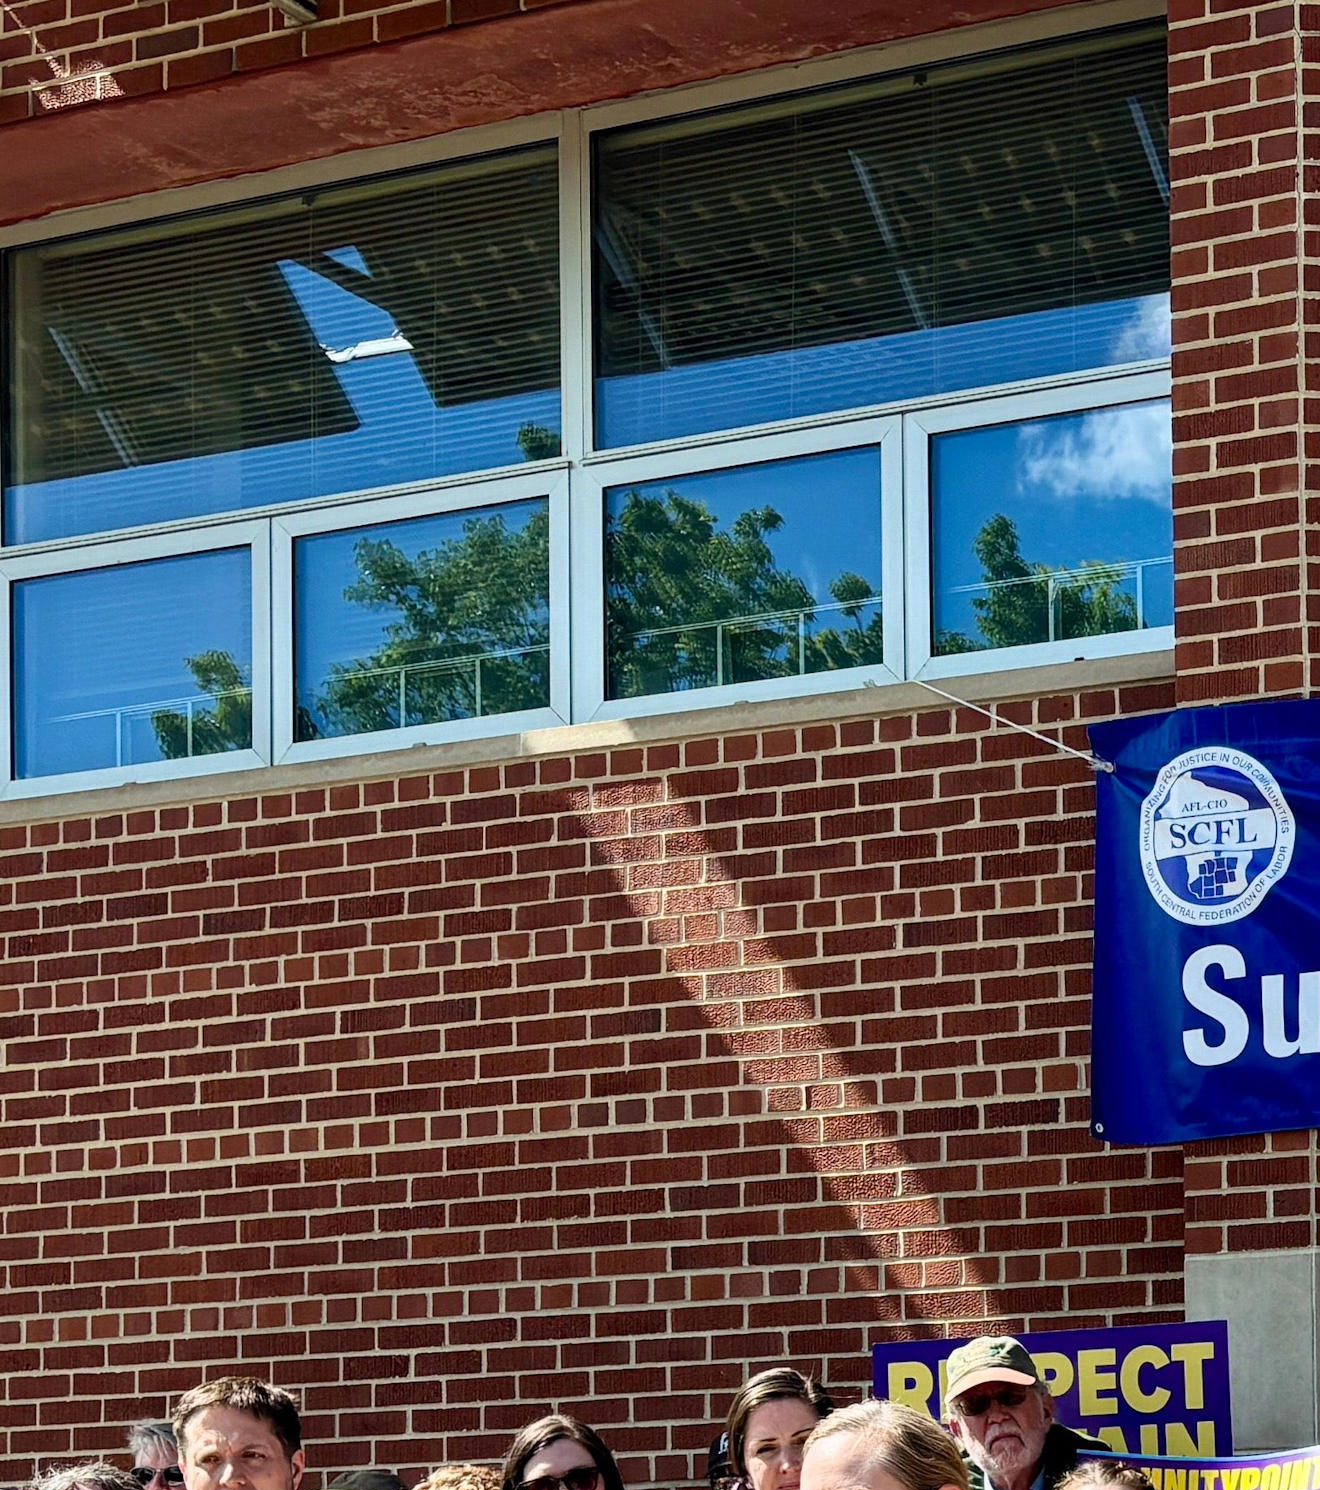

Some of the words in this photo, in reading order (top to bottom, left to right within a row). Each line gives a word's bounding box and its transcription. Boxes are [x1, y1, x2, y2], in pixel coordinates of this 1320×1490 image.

[1144, 784, 1166, 851] ORGANIZING
[1179, 752, 1217, 771] JUSTICE
[1219, 753, 1230, 762] IN
[1232, 756, 1253, 772] OUR
[1169, 817, 1258, 849] SCFL
[1181, 799, 1228, 813] AFL-CIO
[1146, 861, 1162, 896] SOUTH
[1160, 894, 1197, 920] CENTRAL
[1199, 891, 1257, 921] FEDERATION
[1256, 878, 1267, 893] OF
[1266, 846, 1288, 879] LABOR
[888, 1342, 1215, 1425] RPECT
